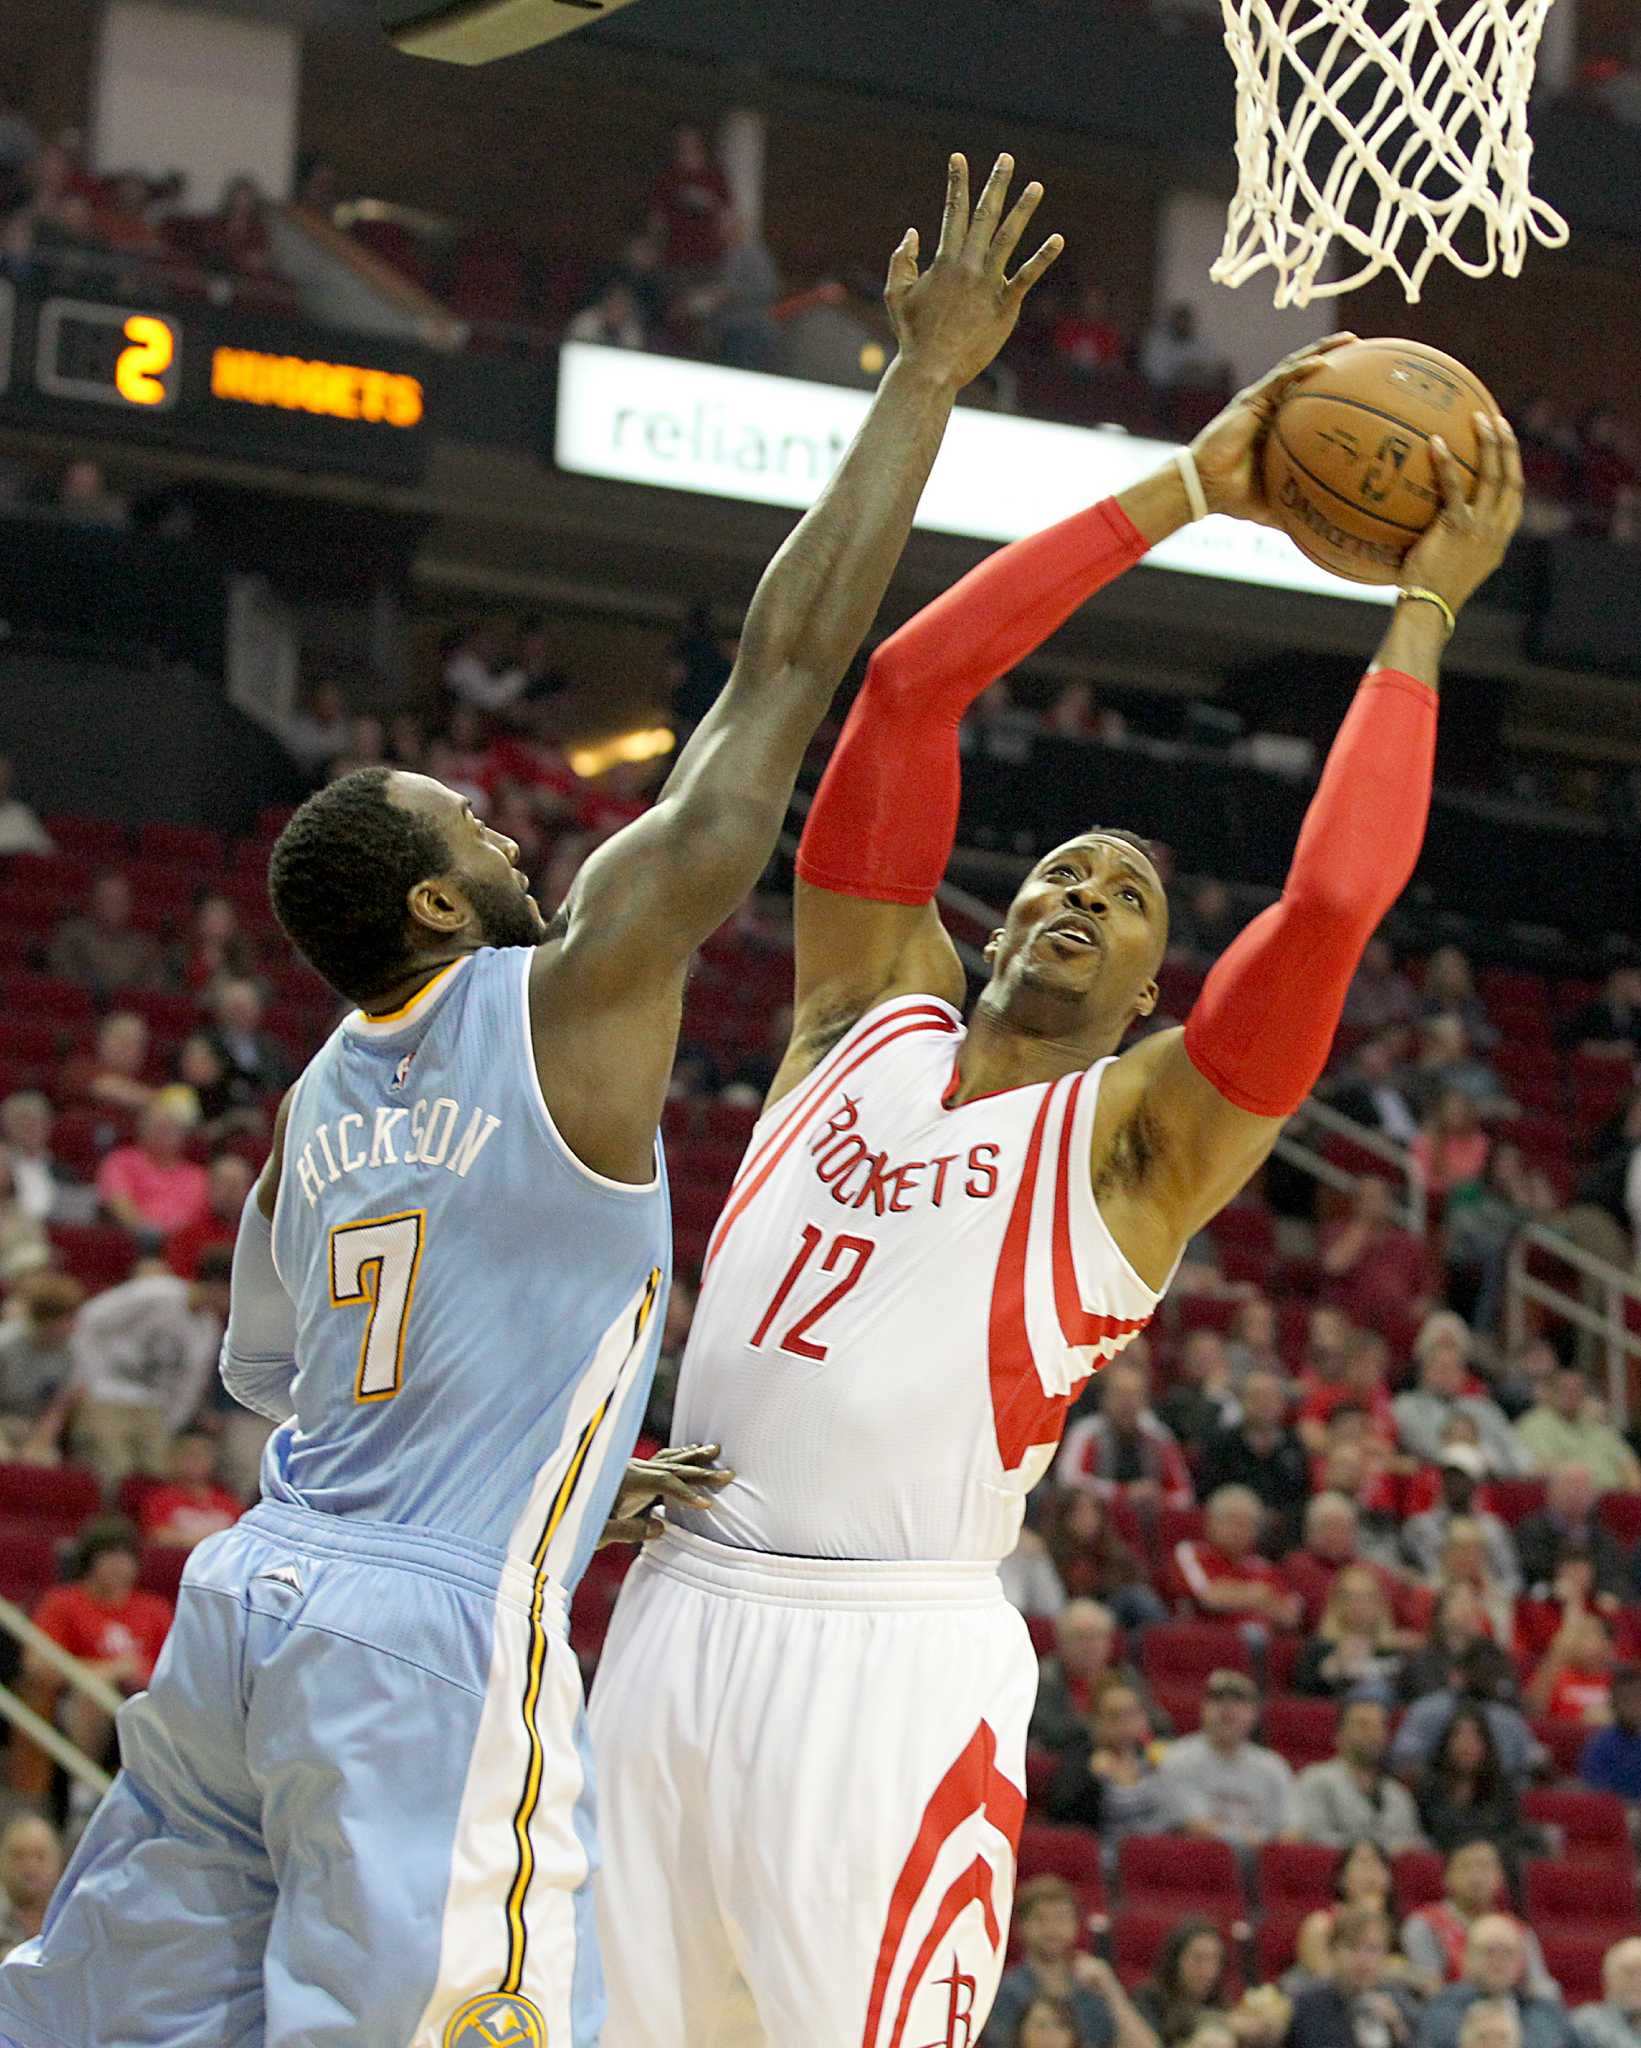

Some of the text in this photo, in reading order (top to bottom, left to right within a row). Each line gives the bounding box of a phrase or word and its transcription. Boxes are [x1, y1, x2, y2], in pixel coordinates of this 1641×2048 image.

[115, 315, 174, 405] 2
[611, 399, 849, 481] reliant
[296, 1097, 501, 1209] HICKSON
[810, 1093, 1001, 1217] ROCKETS
[328, 1208, 427, 1404] 7
[747, 1221, 876, 1364] 12
